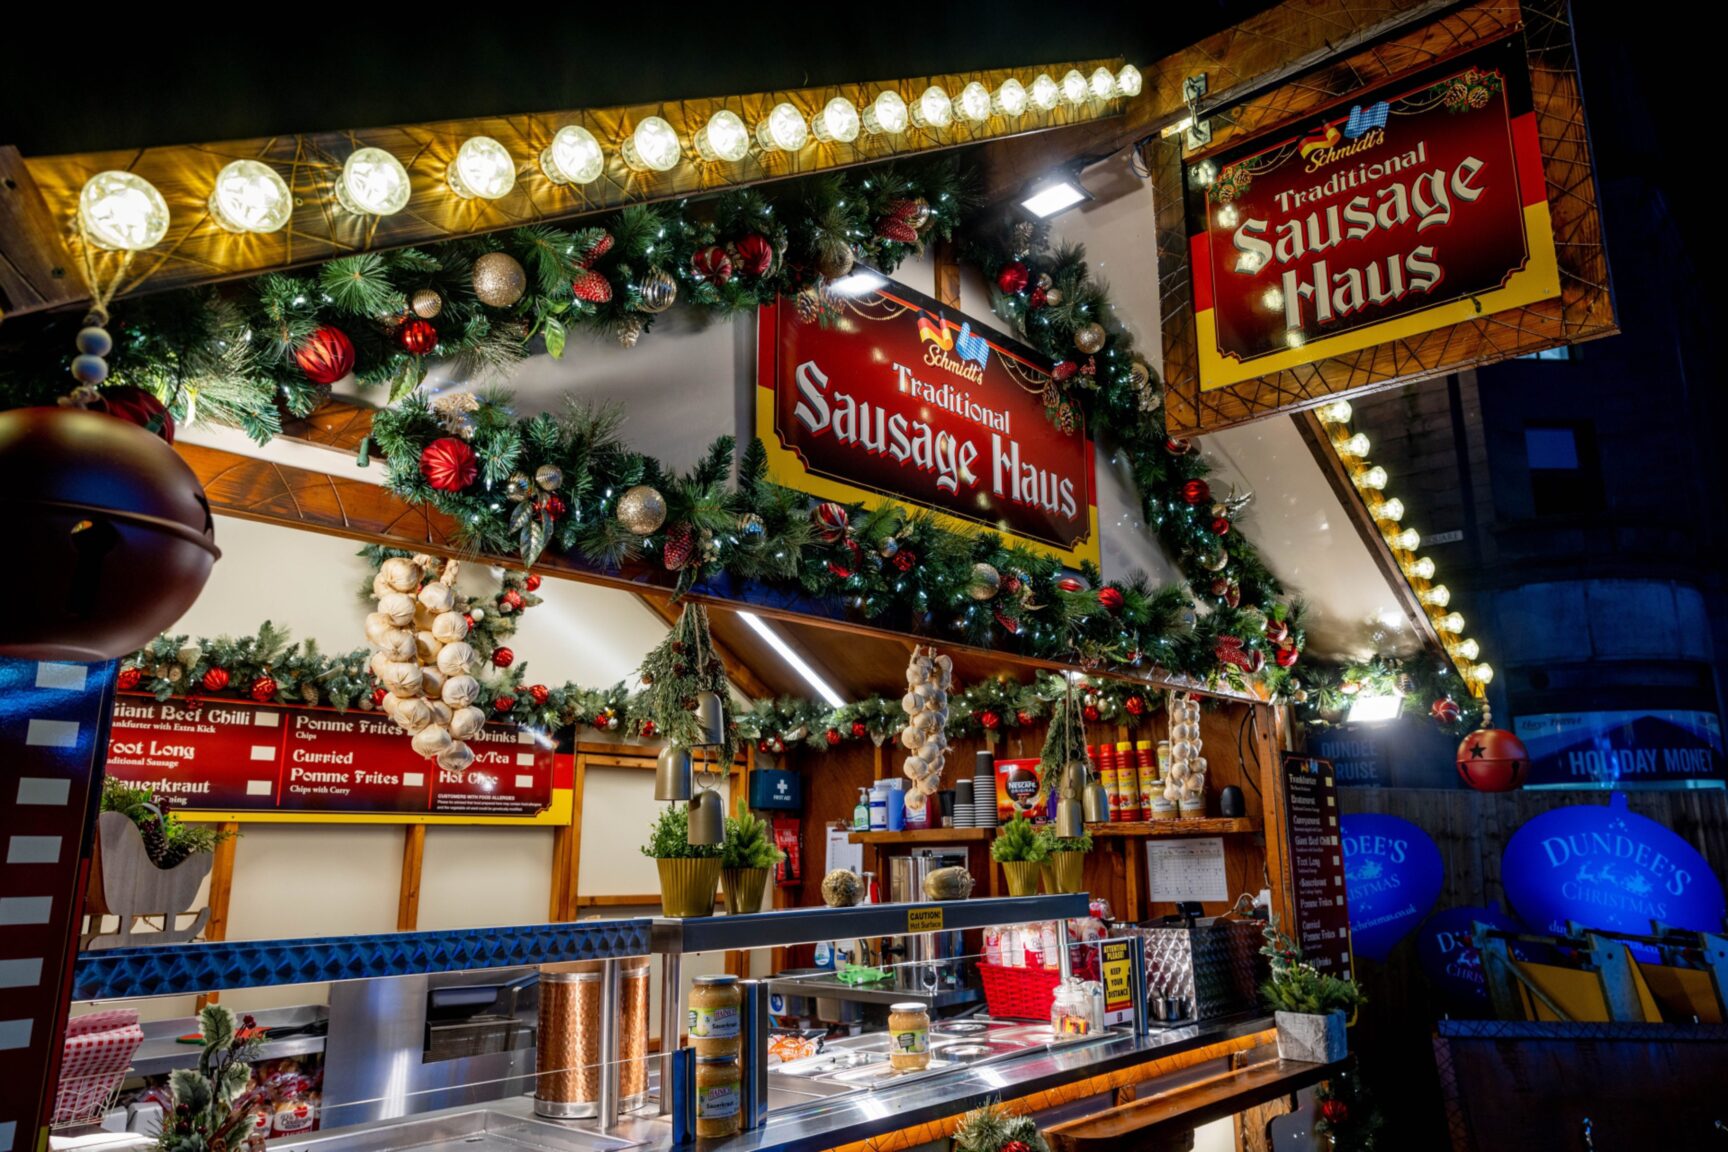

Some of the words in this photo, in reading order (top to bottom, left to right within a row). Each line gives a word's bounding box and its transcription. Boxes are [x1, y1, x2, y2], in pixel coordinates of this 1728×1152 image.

[1304, 129, 1386, 174] Schmidt's
[1275, 141, 1427, 212] Traditional
[1234, 155, 1489, 276] Sausage
[1281, 245, 1442, 331] Haus
[924, 344, 983, 385] Schmidt's
[892, 362, 1009, 434] Traditional
[794, 360, 979, 496] Sausage
[992, 435, 1077, 520] Haus
[112, 719, 151, 731] ankfurter
[153, 722, 171, 731] with
[173, 723, 195, 733] Extra
[196, 724, 216, 733] Kick
[113, 703, 155, 719] iant
[161, 705, 204, 722] Beef
[208, 709, 250, 725] Chilli
[296, 715, 355, 733] Pomme
[358, 719, 404, 736] Frites
[295, 731, 317, 741] Chips
[1321, 739, 1377, 758] DUNDEE
[107, 756, 145, 766] aditional
[146, 758, 179, 769] Sausage
[150, 740, 195, 760] Long
[292, 748, 354, 765] Curried
[1568, 748, 1658, 776] HOLIDAY
[1663, 747, 1713, 773] MONEY
[290, 767, 350, 783] Pomme
[354, 769, 399, 785] Frites
[439, 770, 463, 783] Hot
[1335, 761, 1378, 780] RUISE
[289, 785, 311, 795] Chips
[312, 786, 328, 794] with
[329, 786, 351, 796] Curry
[1341, 835, 1408, 864] DEE'S
[1541, 831, 1692, 897] DUNDEE'S
[1347, 873, 1400, 902] ISTMAS
[1562, 881, 1667, 919] CHRISTMAS
